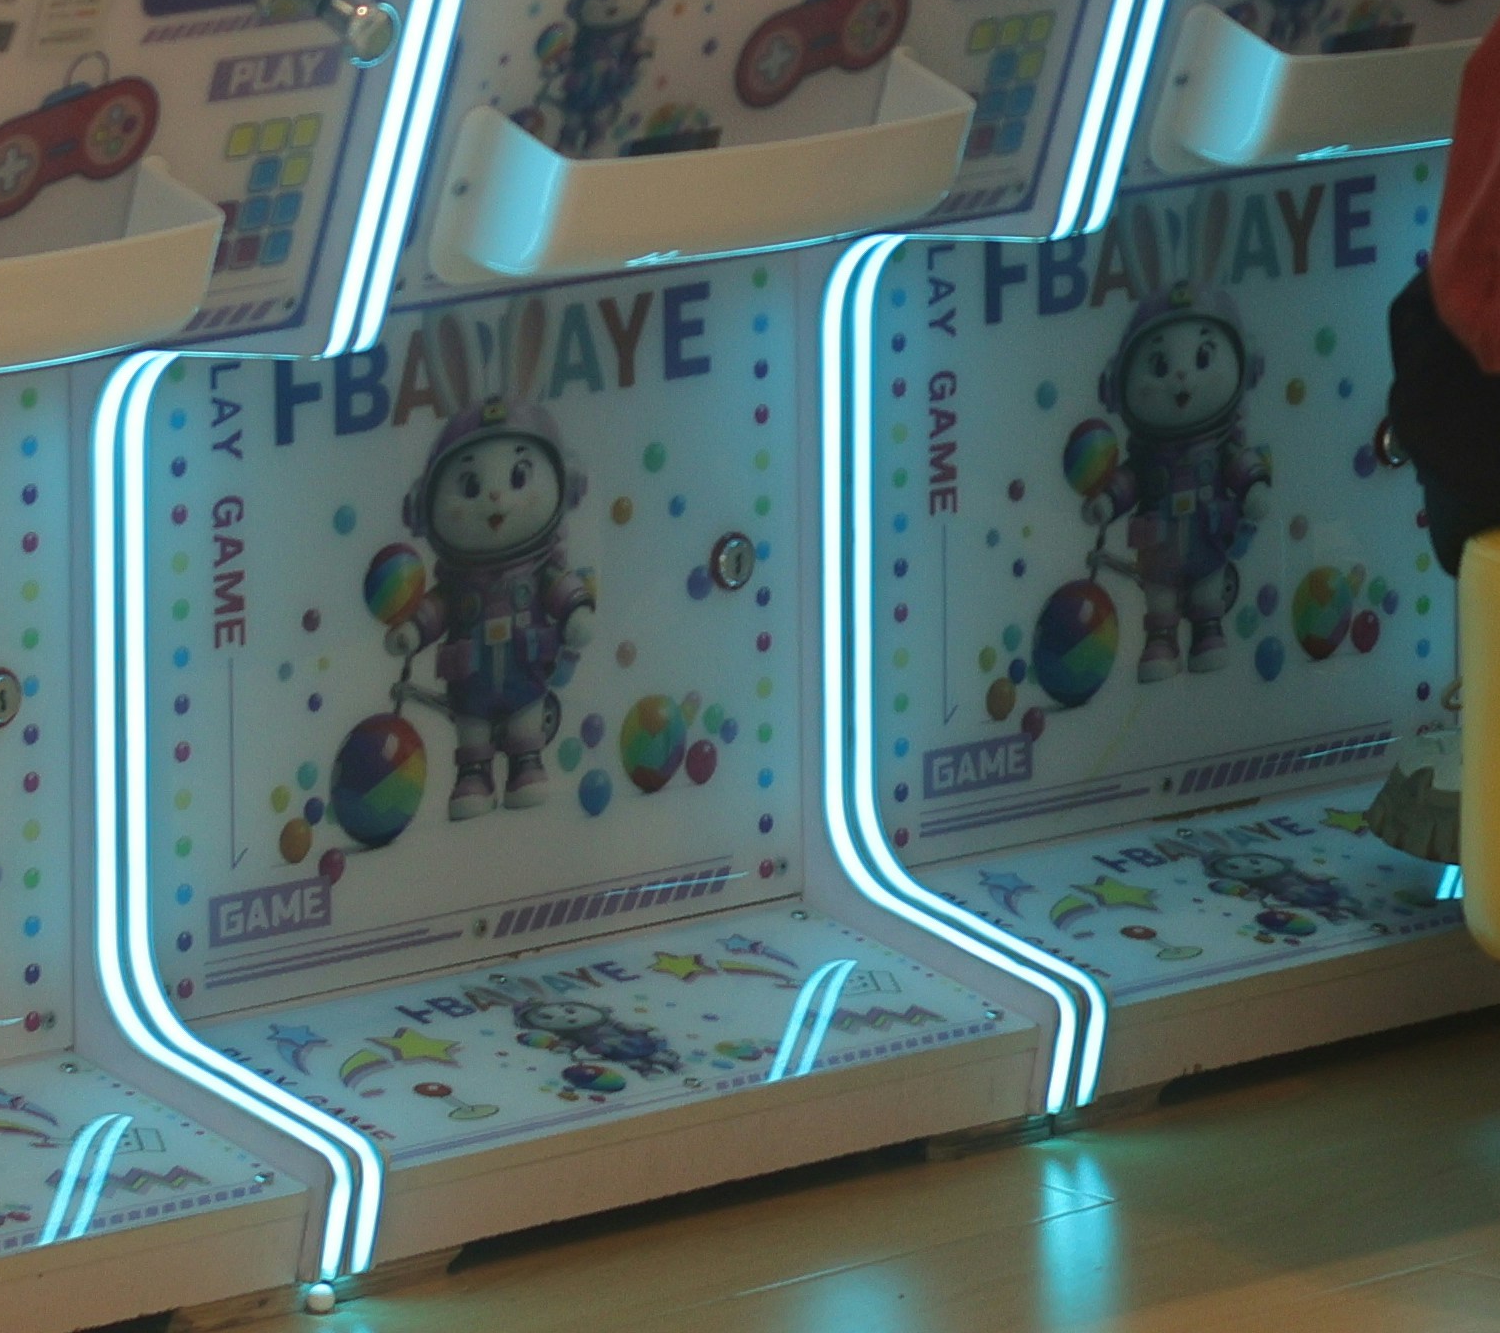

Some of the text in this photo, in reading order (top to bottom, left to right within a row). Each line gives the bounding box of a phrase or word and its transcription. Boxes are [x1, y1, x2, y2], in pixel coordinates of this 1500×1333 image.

[222, 51, 326, 97] PLAY
[925, 241, 961, 518] LAY GAME
[208, 360, 247, 650] LAY GAME
[931, 739, 1028, 791] GAME
[218, 882, 326, 935] GAME
